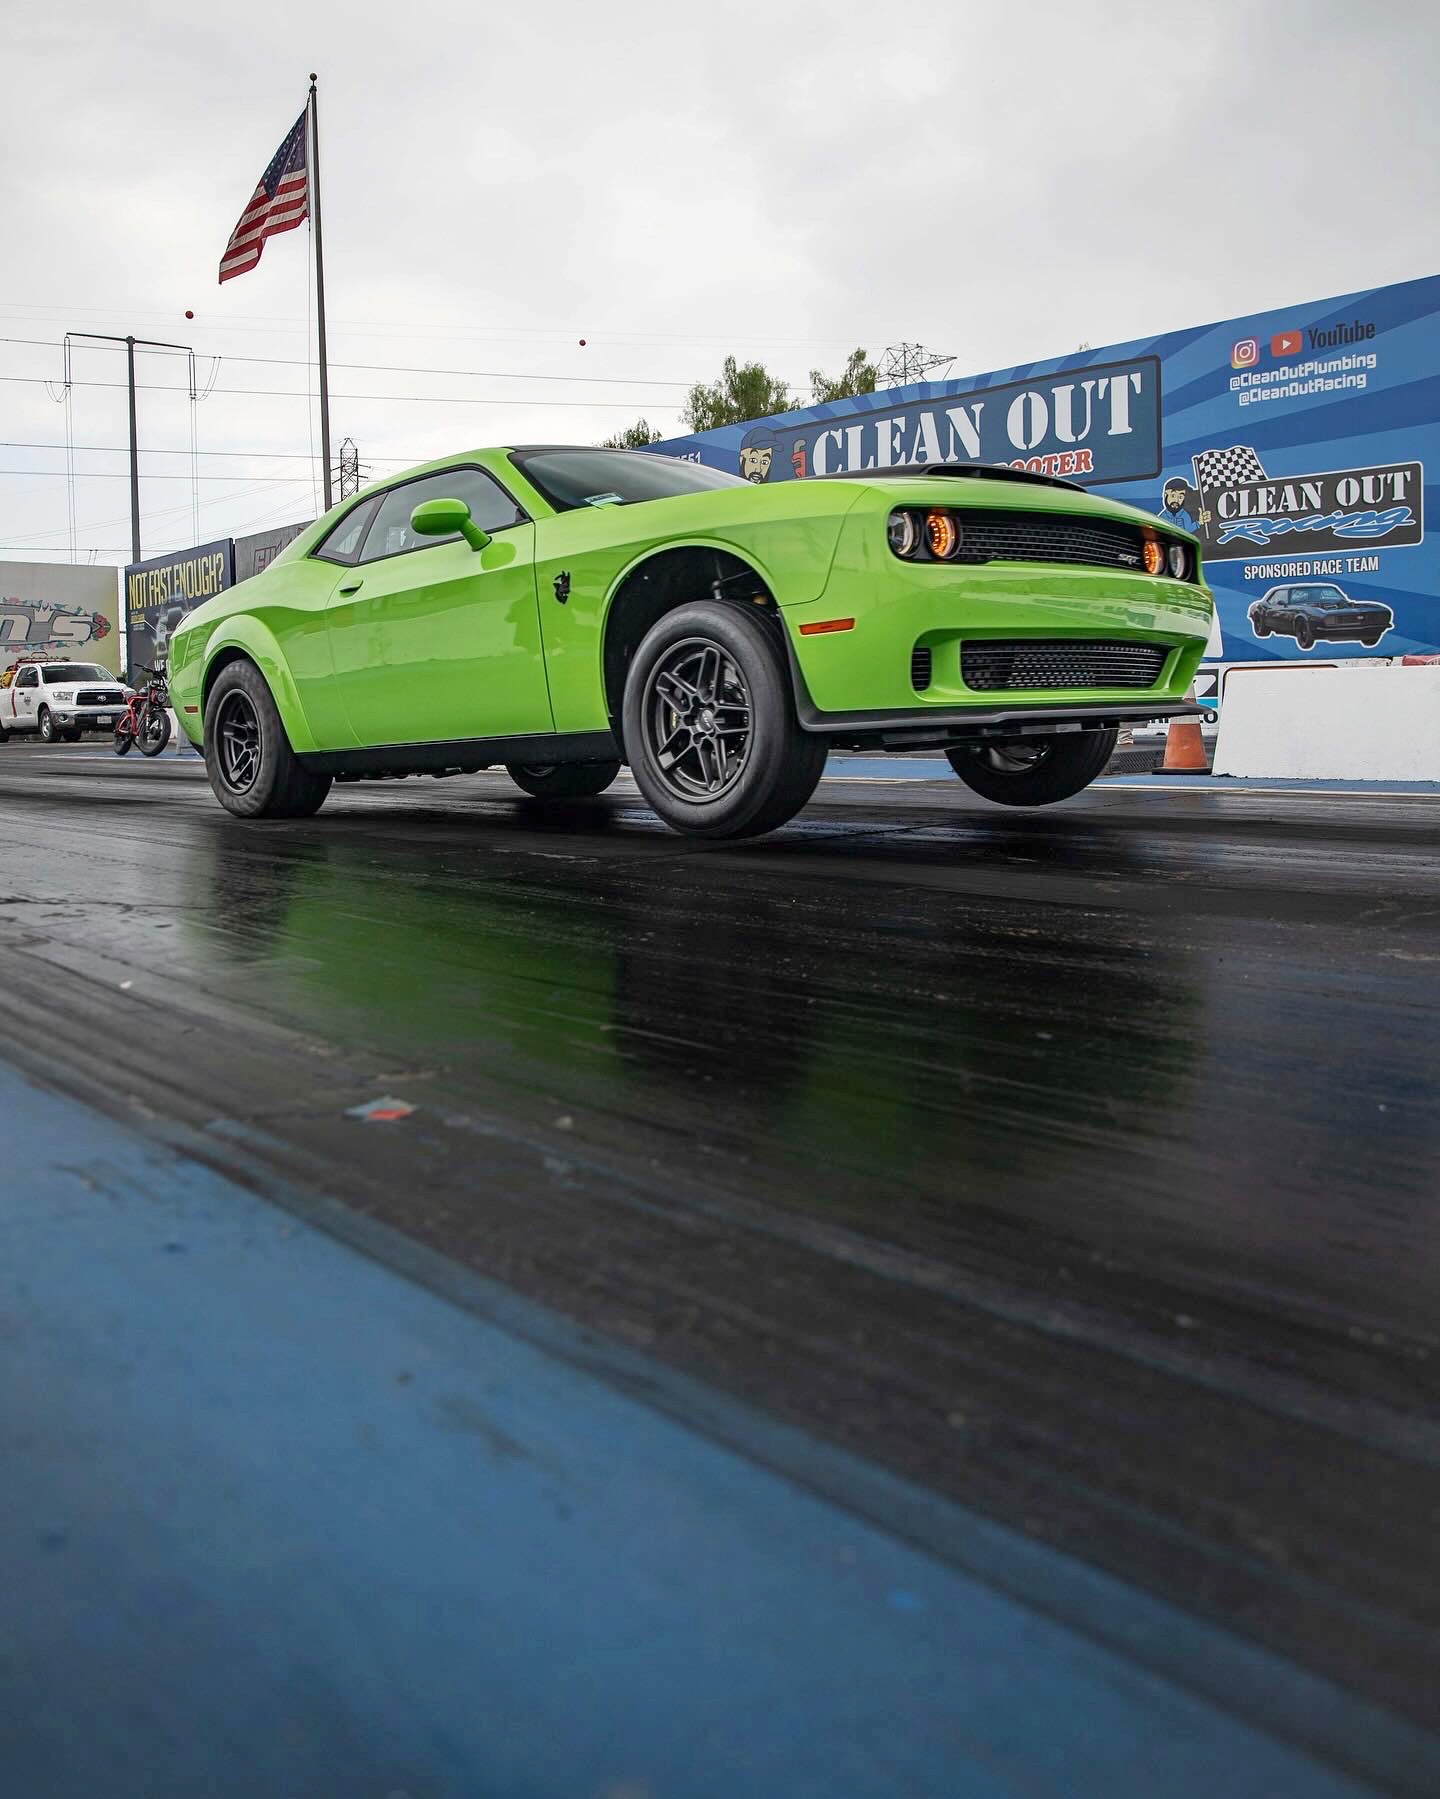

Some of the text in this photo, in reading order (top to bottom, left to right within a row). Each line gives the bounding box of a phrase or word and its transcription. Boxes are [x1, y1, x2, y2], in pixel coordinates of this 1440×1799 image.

[1309, 320, 1376, 349] YouTube
[1230, 353, 1377, 390] @CleanOutPlumbing
[1239, 373, 1367, 406] @CleanOutRacing
[812, 373, 1142, 476] CLEAN OUT
[992, 449, 1094, 476] OTER
[1217, 471, 1411, 519] CLEAN OUT
[1217, 506, 1416, 545] Racing
[129, 552, 224, 610] NOT FAST ENOUGH?
[1244, 556, 1379, 580] SPONSORED RACE TEAM
